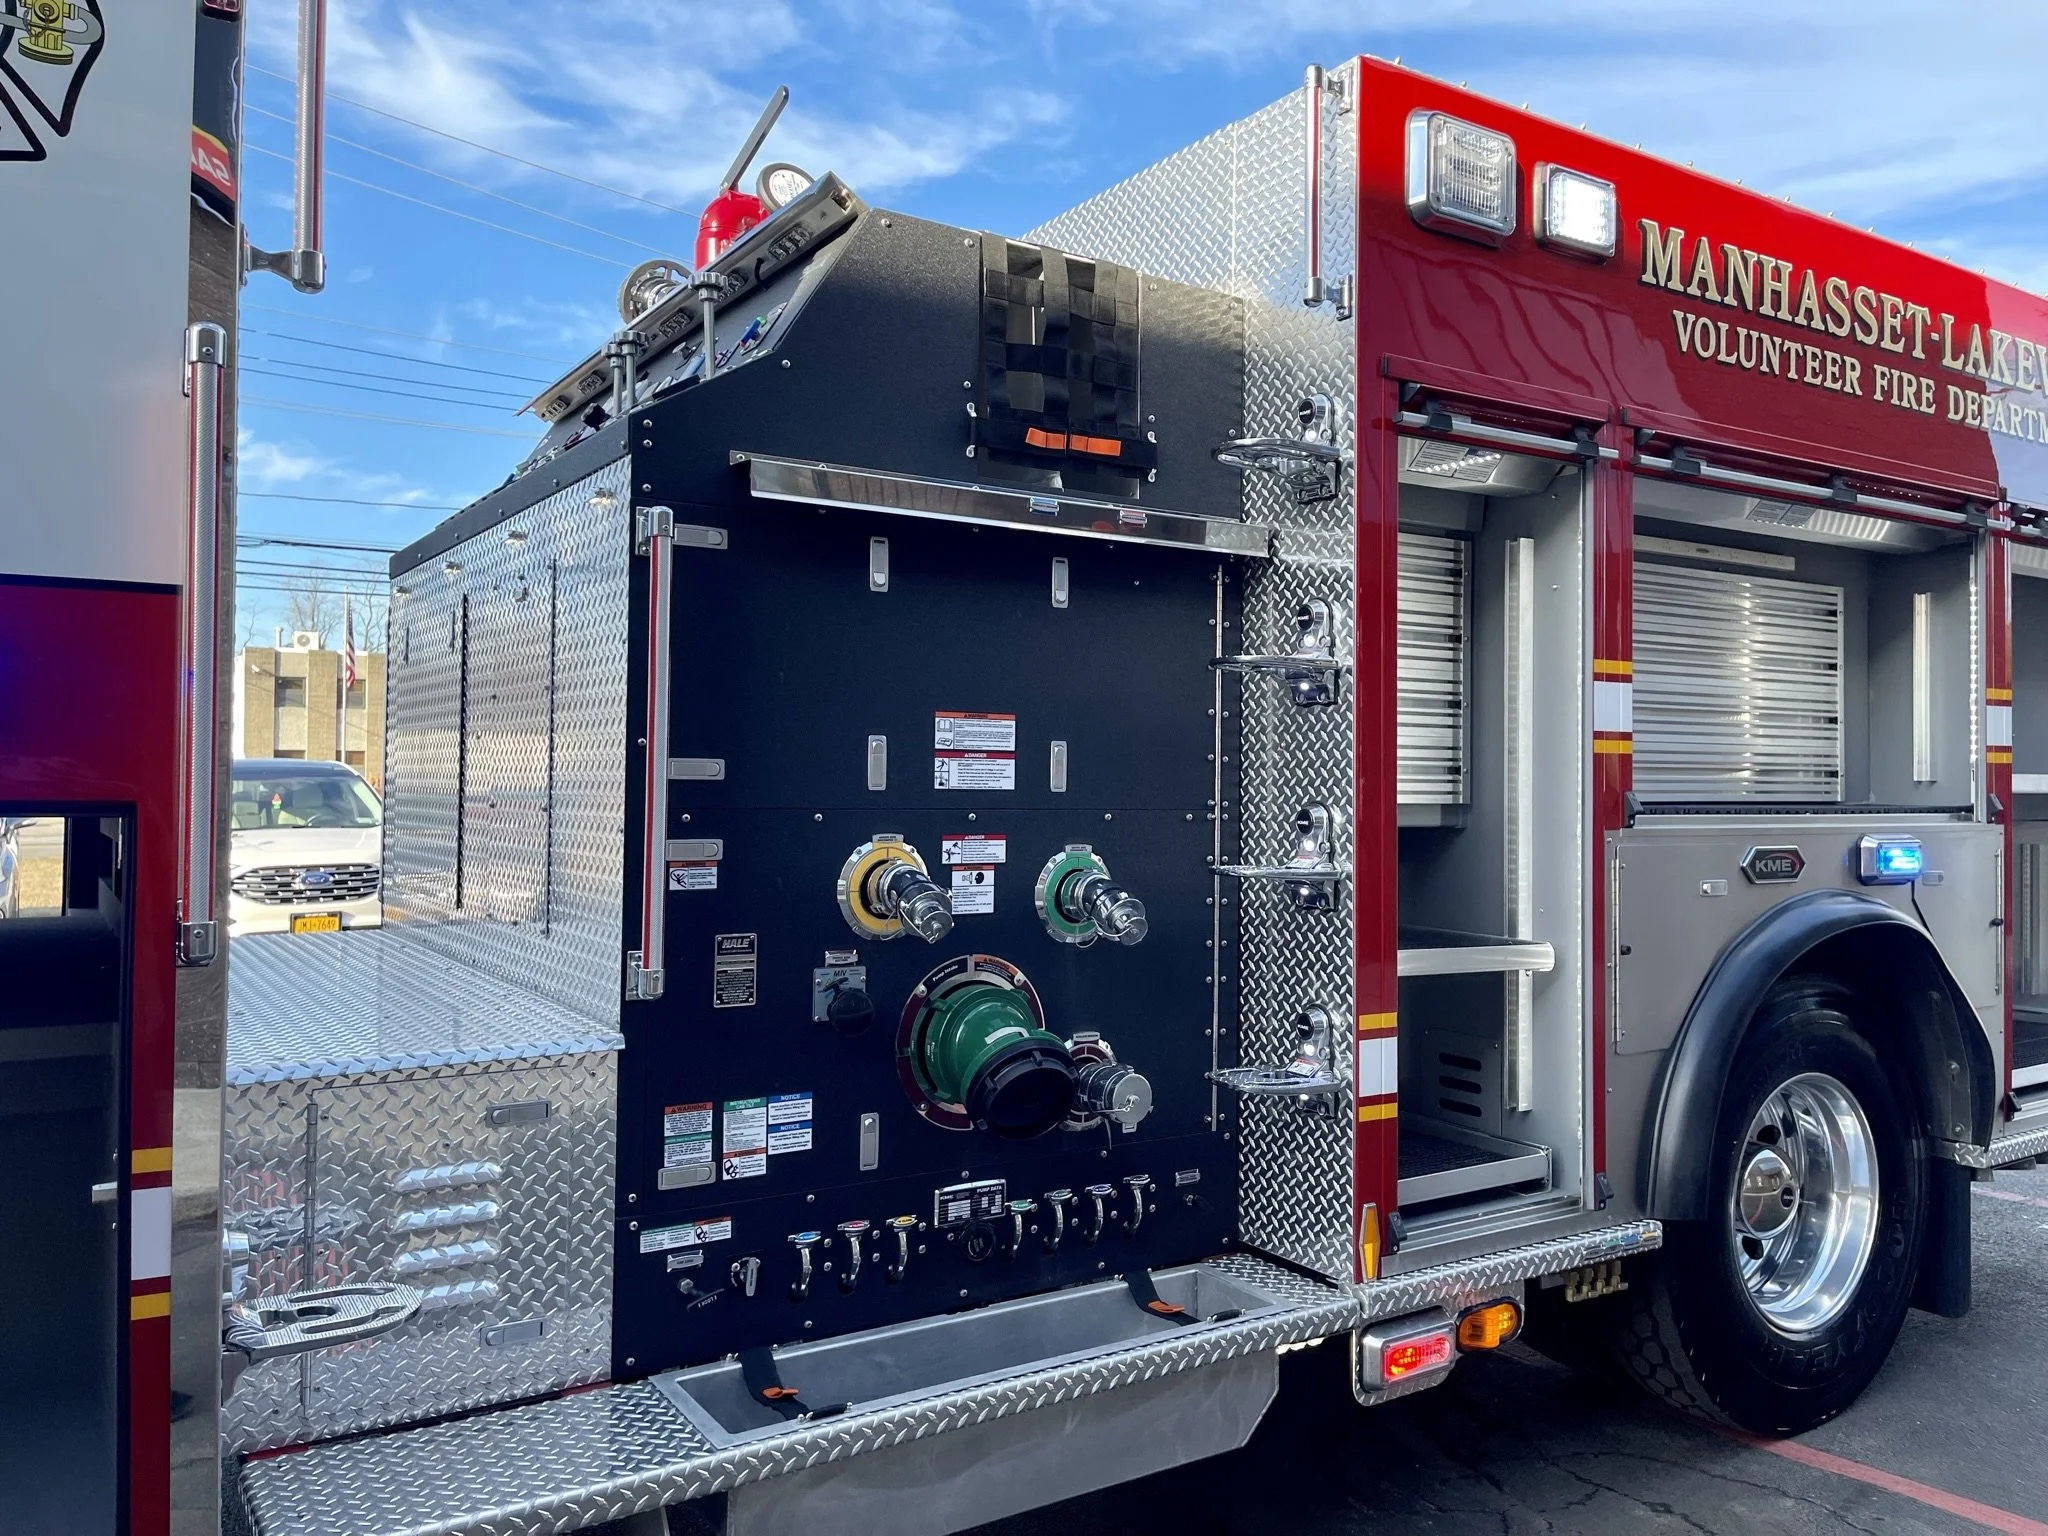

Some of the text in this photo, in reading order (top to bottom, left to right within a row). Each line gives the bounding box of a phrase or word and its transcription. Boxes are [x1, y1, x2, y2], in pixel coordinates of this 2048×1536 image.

[1673, 310, 1862, 396] VOLUNTEER
[1874, 364, 1936, 414] FIRE
[1755, 859, 1792, 873] KME
[722, 938, 750, 949] HALE
[932, 970, 945, 982] Pump
[781, 1093, 801, 1101] NOTICE
[677, 1103, 708, 1112] WARNING
[780, 1123, 800, 1131] NOTICE
